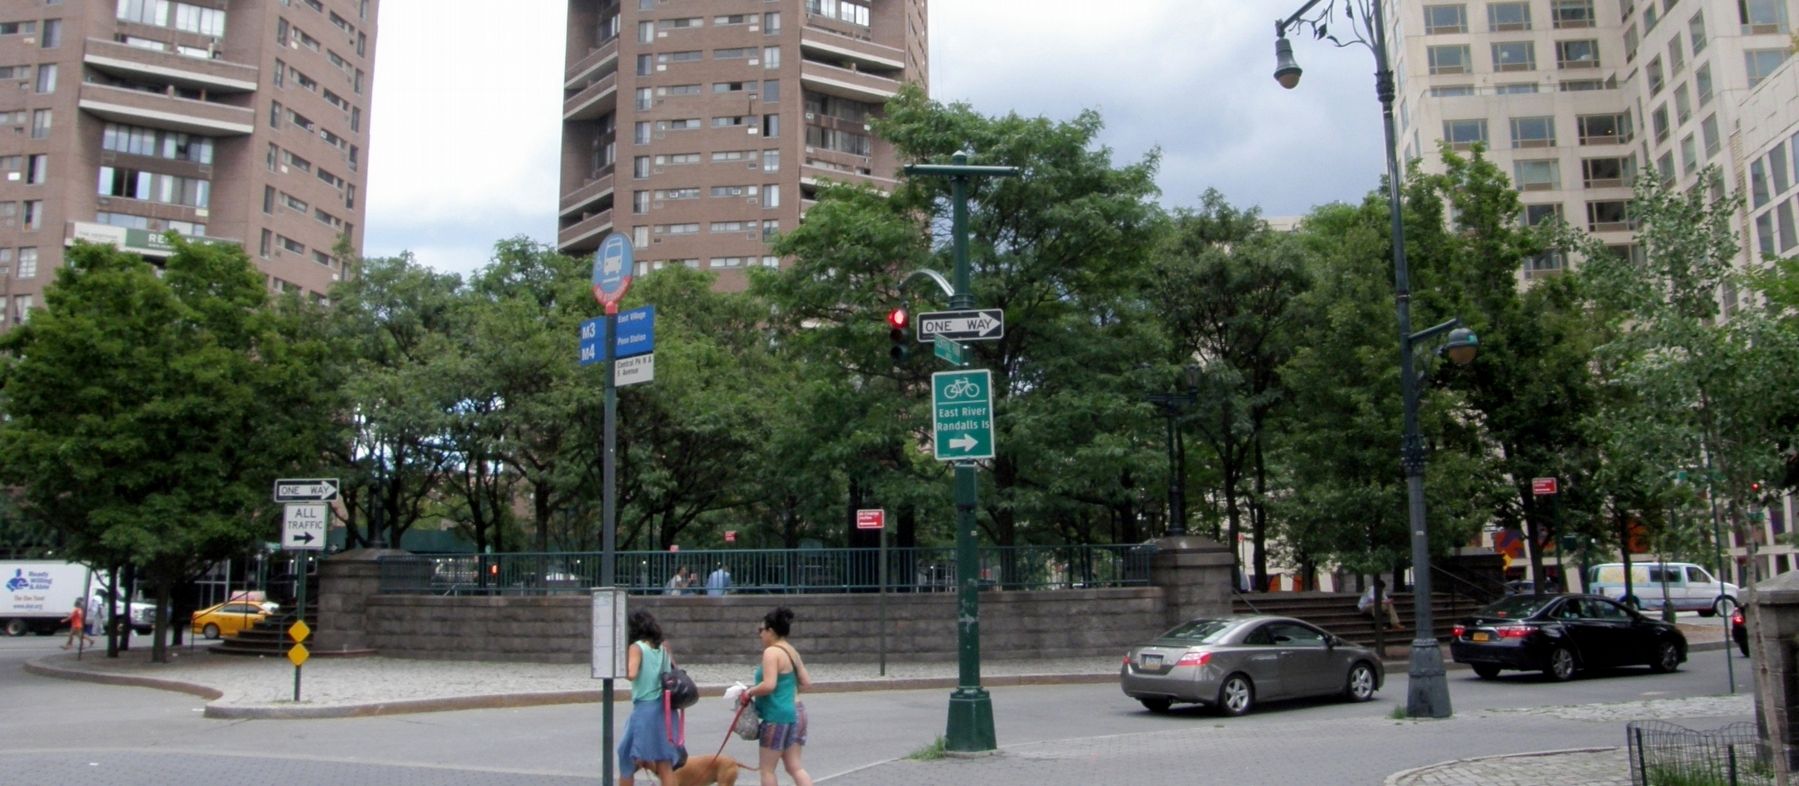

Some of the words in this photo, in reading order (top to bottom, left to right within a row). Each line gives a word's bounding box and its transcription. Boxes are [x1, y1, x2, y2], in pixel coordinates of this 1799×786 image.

[582, 322, 596, 339] M3
[925, 321, 952, 332] ONE
[966, 319, 992, 330] WAY
[581, 343, 595, 361] M4
[939, 408, 958, 418] East
[962, 406, 986, 417] River
[937, 421, 978, 432] Randalls
[981, 420, 990, 429] Is
[281, 486, 300, 495] ONE
[310, 485, 329, 494] WAY
[294, 507, 316, 518] ALL
[288, 521, 323, 530] TRAFFIC
